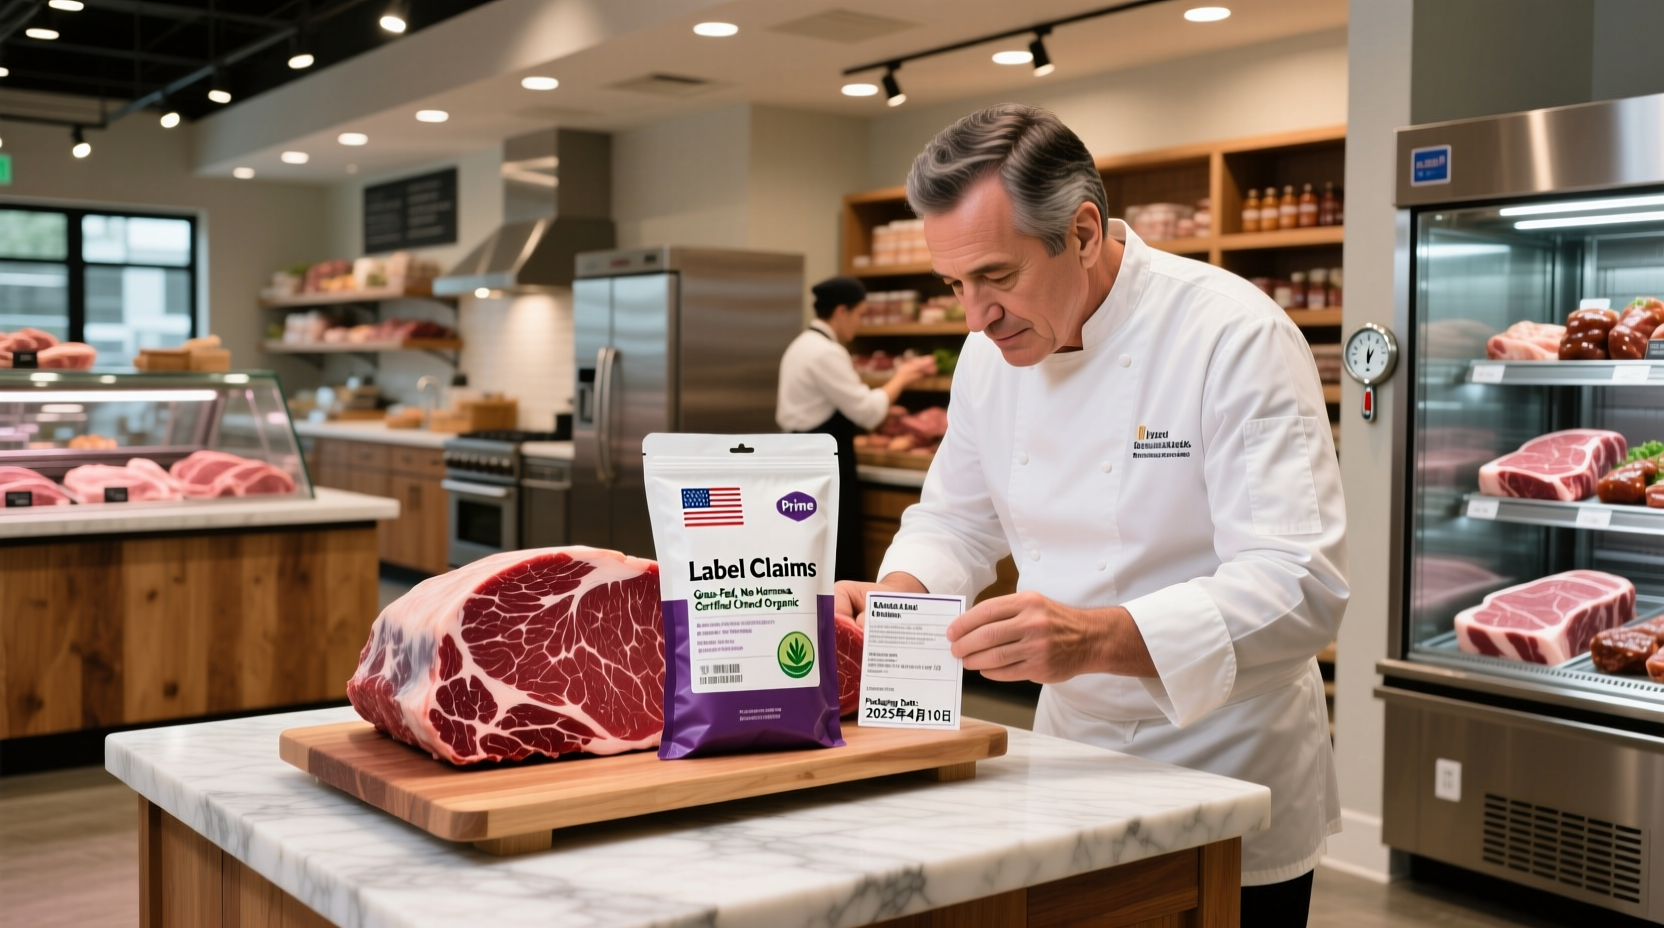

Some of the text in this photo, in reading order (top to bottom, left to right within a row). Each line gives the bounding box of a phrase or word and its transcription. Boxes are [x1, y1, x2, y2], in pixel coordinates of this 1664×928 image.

[782, 499, 813, 512] Prime
[689, 556, 817, 581] Label Claims
[865, 707, 951, 722] 2025年4月10日
